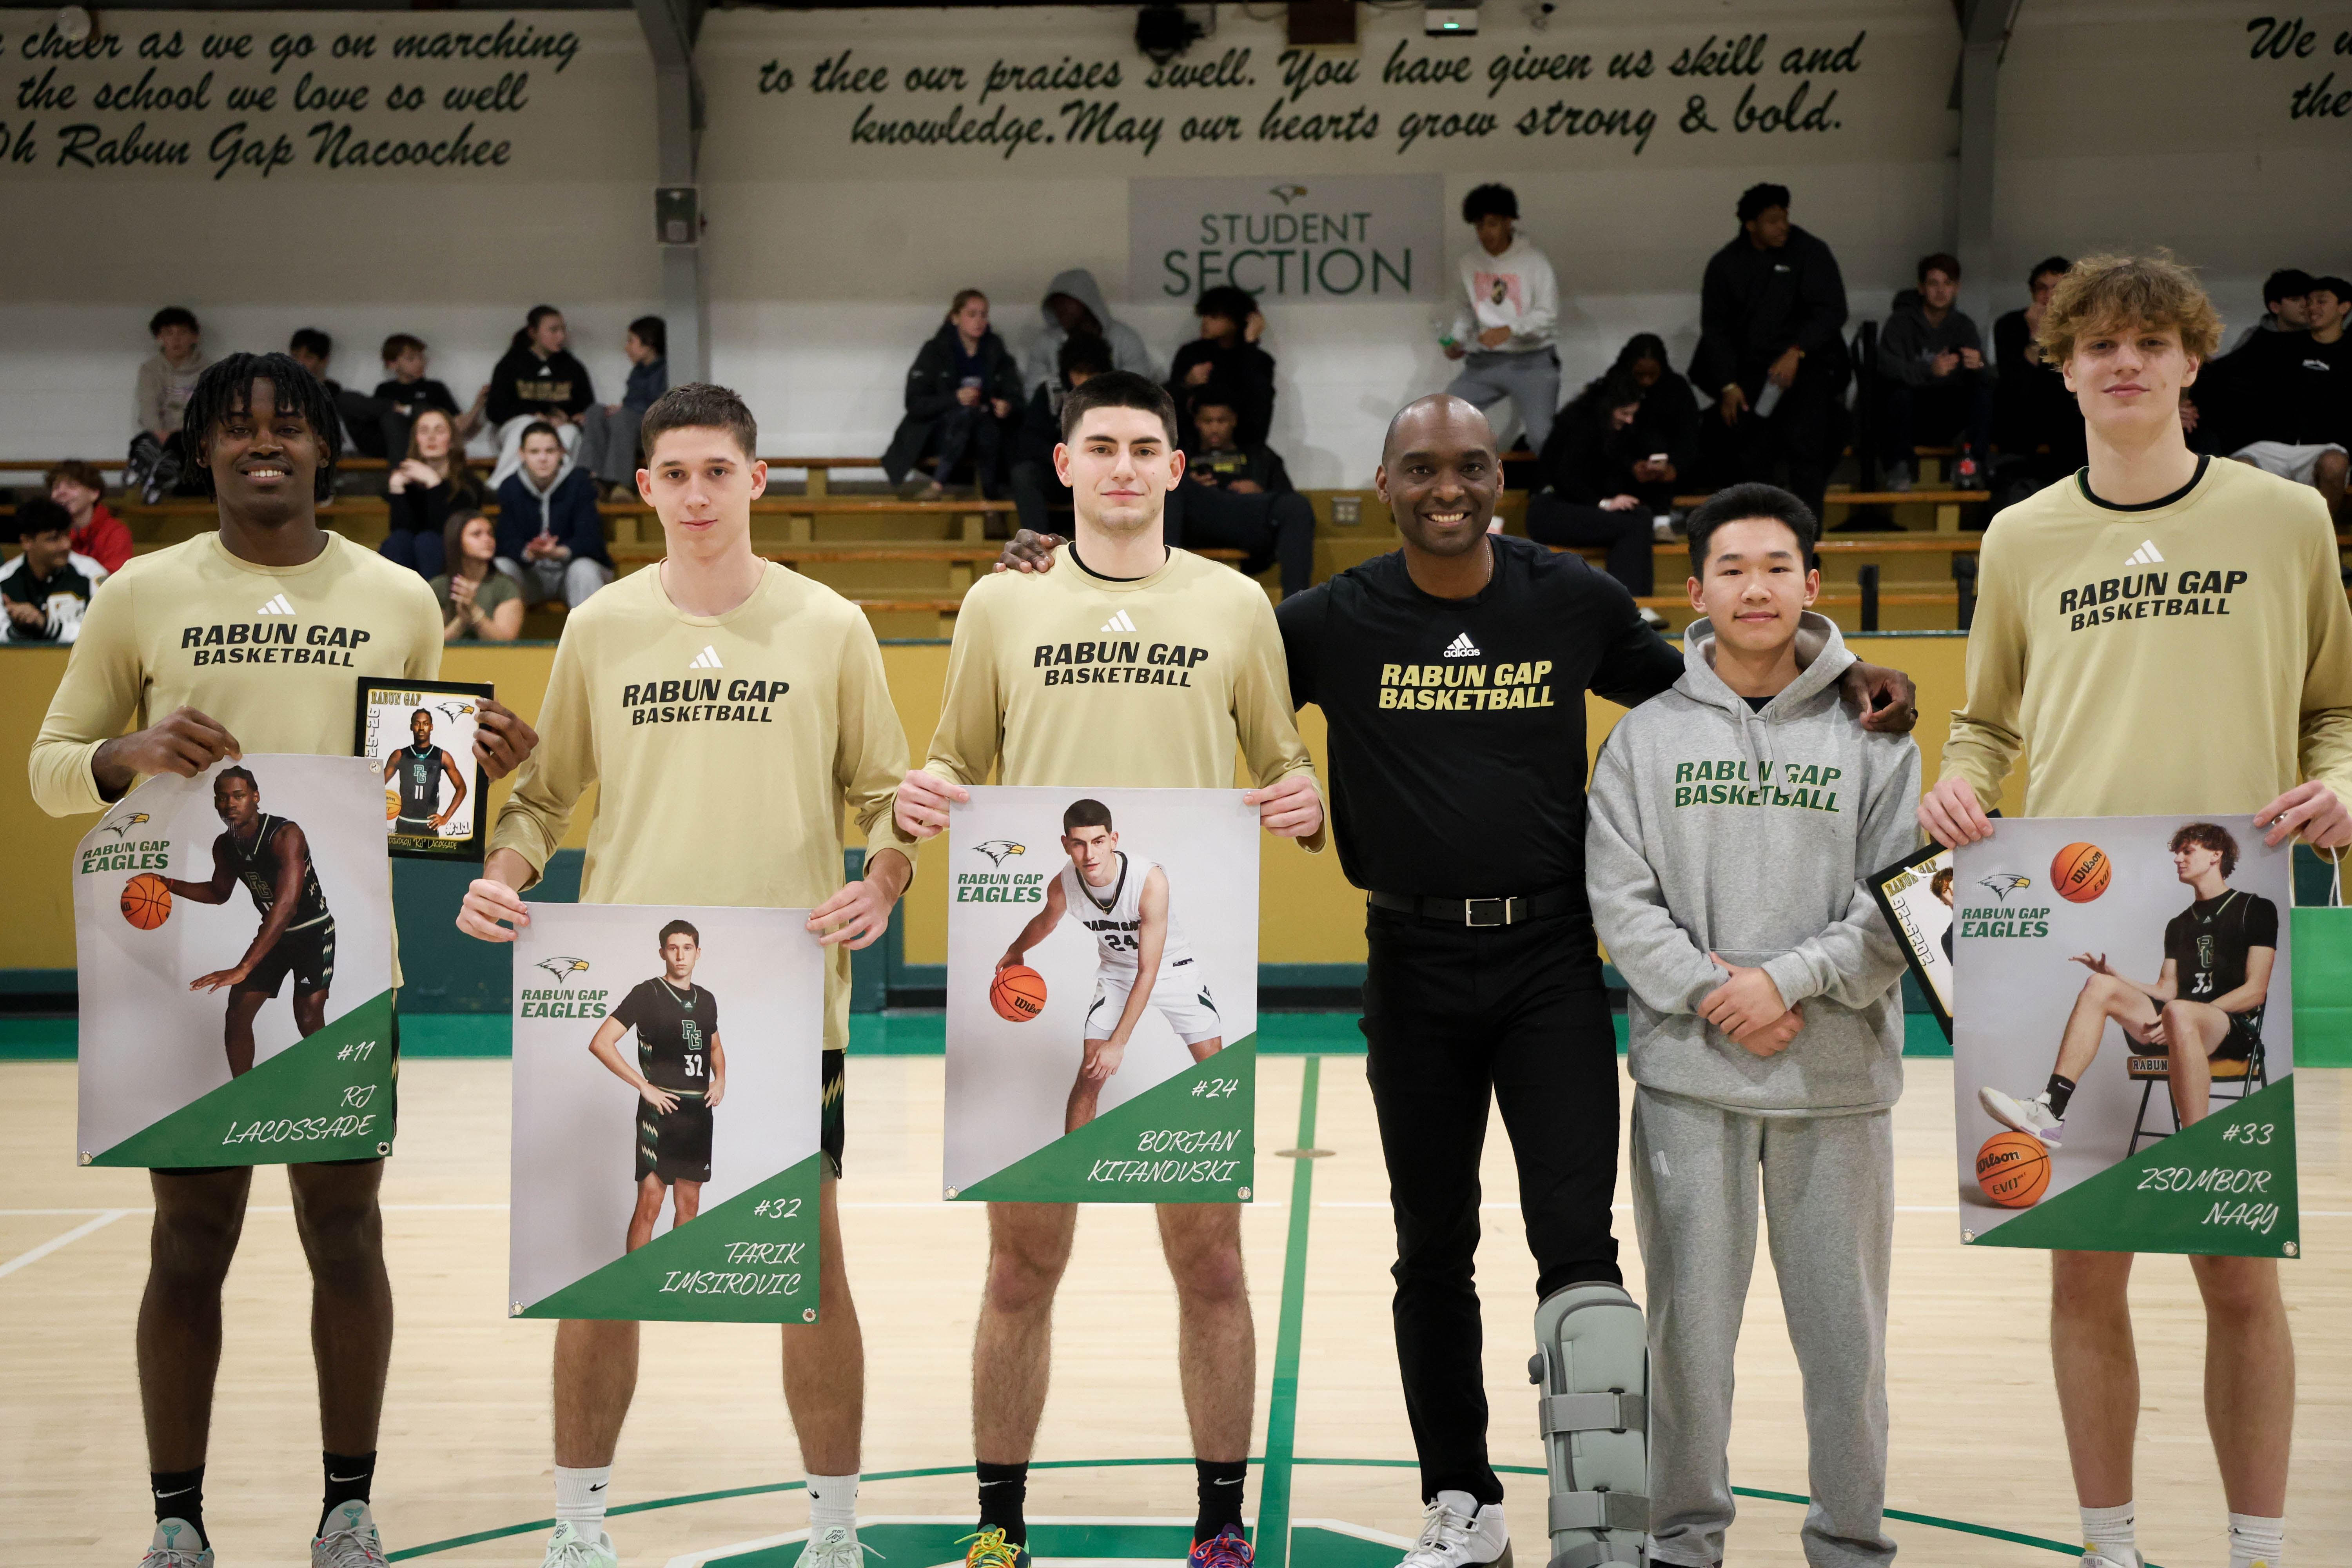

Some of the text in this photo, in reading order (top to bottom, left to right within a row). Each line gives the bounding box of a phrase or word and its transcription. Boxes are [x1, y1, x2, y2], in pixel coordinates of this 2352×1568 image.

[22, 22, 123, 59] cheer
[139, 32, 184, 59] as
[203, 32, 252, 58] we
[270, 32, 314, 74] go
[332, 32, 376, 58] on
[394, 18, 581, 73] marching
[2247, 16, 2316, 59] We
[759, 31, 1866, 103] to thee our praises swell. You have given us skill and
[18, 66, 528, 112] the school we love so well
[2291, 72, 2352, 120] the
[1180, 114, 1242, 142] our
[1259, 97, 1381, 142] hearts
[1398, 109, 1497, 154] grow
[1513, 98, 1656, 155] strong
[1679, 94, 1717, 133] &
[1733, 82, 1842, 133] bold.
[57, 121, 191, 168] Rabun
[208, 122, 296, 180] Gap
[307, 120, 512, 169] Nacoochee
[1201, 211, 1372, 245] STUDENT
[1163, 248, 1412, 297] SECTION
[2060, 570, 2248, 614] RABUN GAP
[2071, 598, 2230, 632] BASKETBALL
[181, 623, 370, 649] RABUN GAP
[194, 648, 354, 667] BASKETBALL
[1034, 641, 1209, 668] RABUN GAP
[1443, 647, 1480, 658] adidas
[1045, 667, 1191, 687] BASKETBALL
[1381, 661, 1552, 687] RABUN GAP
[371, 691, 422, 706] RABUN GAP
[622, 679, 789, 707] RABUN GAP
[1379, 686, 1554, 710] BASKETBALL
[632, 705, 772, 726] BASKETBALL
[1785, 764, 1841, 786] GAP
[415, 785, 423, 800] 11
[446, 821, 470, 835] #11
[83, 841, 170, 860] RABUN GAP
[428, 839, 458, 850] LACOSSADE
[82, 854, 169, 874] EAGLES
[2071, 851, 2102, 884] Wilson
[958, 874, 1044, 885] RABUN GAP
[1885, 873, 1918, 897] RABUN
[957, 887, 1042, 903] EAGLES
[1962, 908, 2050, 919] RABUN GAP
[1961, 921, 2049, 937] EAGLES
[1105, 935, 1139, 952] 24
[521, 989, 608, 1000] RABUN GAP
[521, 1002, 607, 1018] EAGLES
[337, 1041, 376, 1062] #11
[684, 1054, 703, 1077] 32
[2133, 1059, 2168, 1071] RABUN
[341, 1084, 377, 1108] RJ
[1191, 1078, 1238, 1098] #24
[222, 1114, 376, 1145] LACOSSADE
[2223, 1123, 2274, 1144] #33
[1138, 1129, 1241, 1154] BORJAN
[1087, 1159, 1240, 1182] KITANOVSKI
[1977, 1151, 2021, 1174] Wilson
[2137, 1167, 2271, 1193] ZSOMBOR
[754, 1198, 802, 1219] #32
[2201, 1201, 2279, 1235] NAGY
[724, 1242, 805, 1264] TARIK
[659, 1270, 801, 1295] IMSIROVIC
